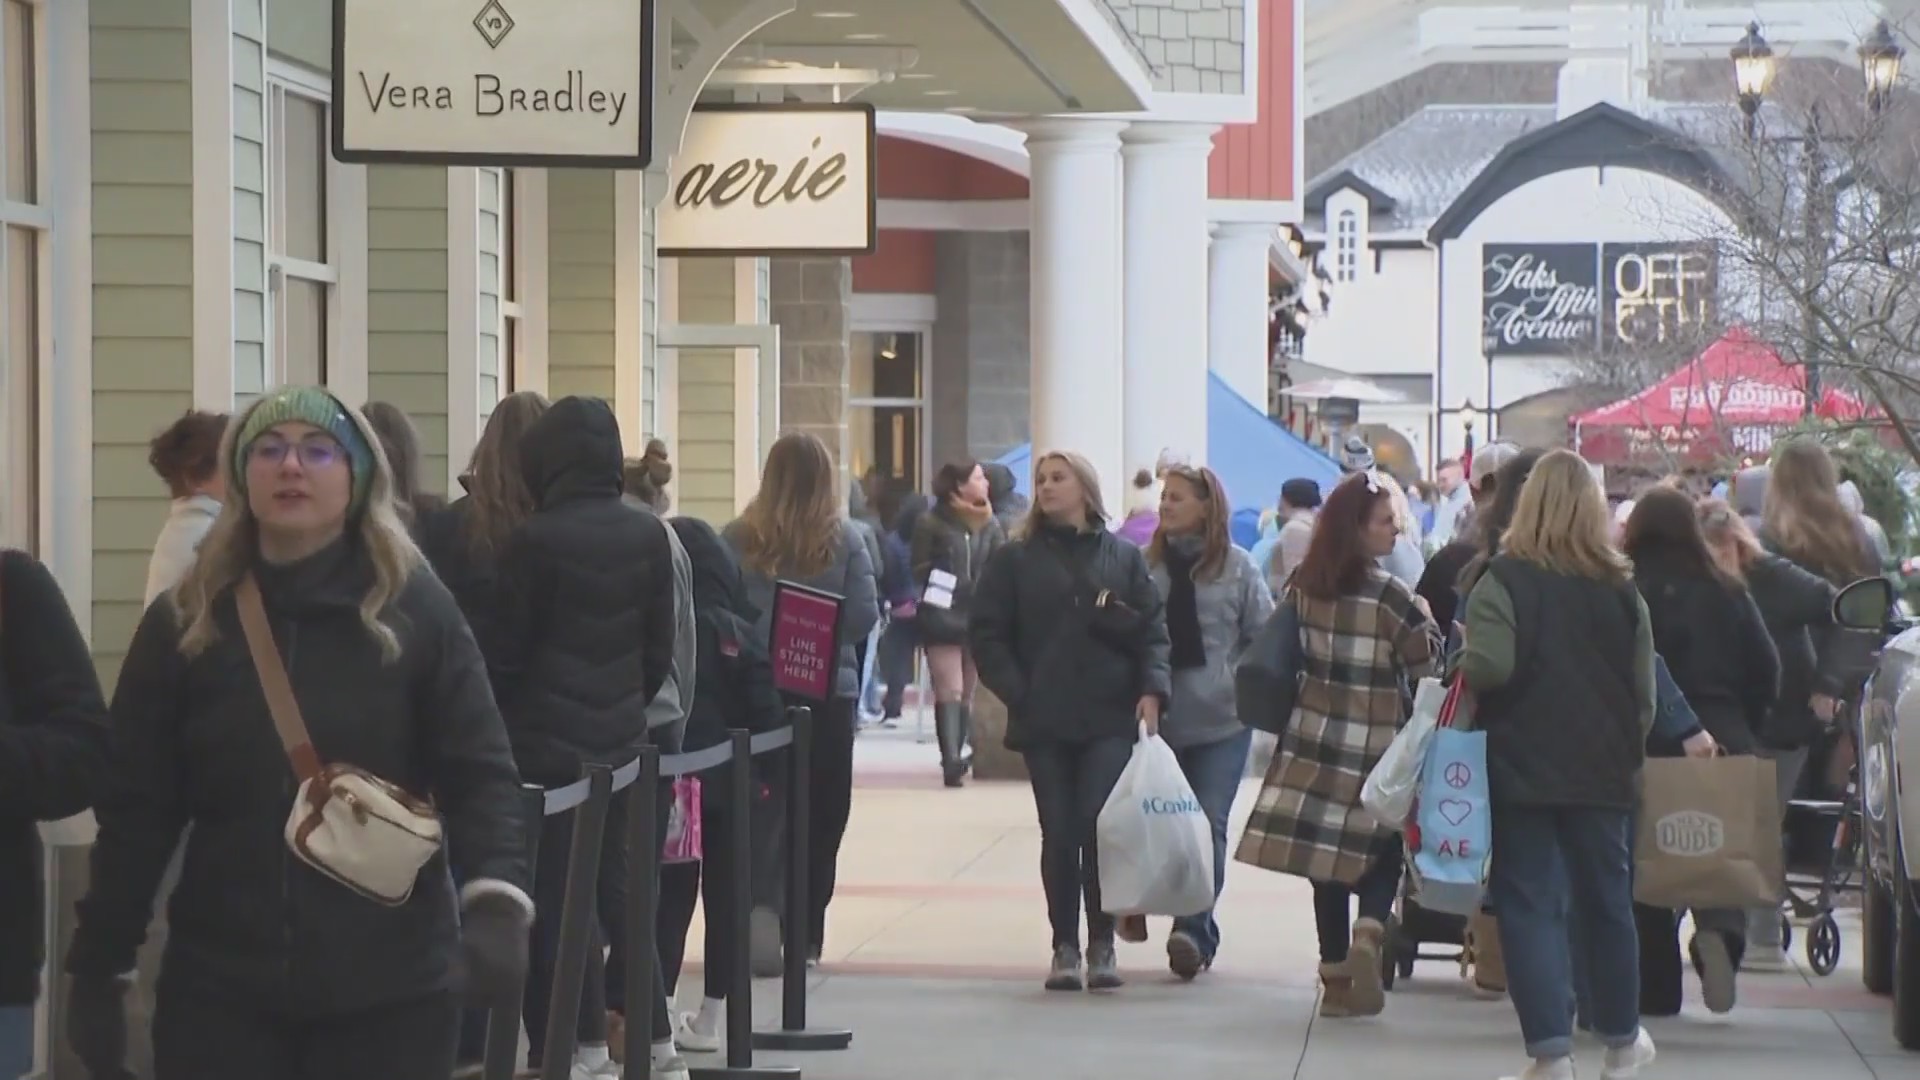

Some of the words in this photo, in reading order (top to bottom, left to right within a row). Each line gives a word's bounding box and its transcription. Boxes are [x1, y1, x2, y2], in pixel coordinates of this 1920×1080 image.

[359, 71, 453, 113] Vera
[475, 70, 627, 126] Bradley
[675, 136, 847, 210] aerie
[1484, 253, 1557, 297] Saks
[1615, 253, 1706, 304] OFF
[780, 648, 824, 670] STARTS
[790, 636, 817, 653] LINE
[784, 664, 816, 682] HERE
[1662, 821, 1718, 851] DUDE
